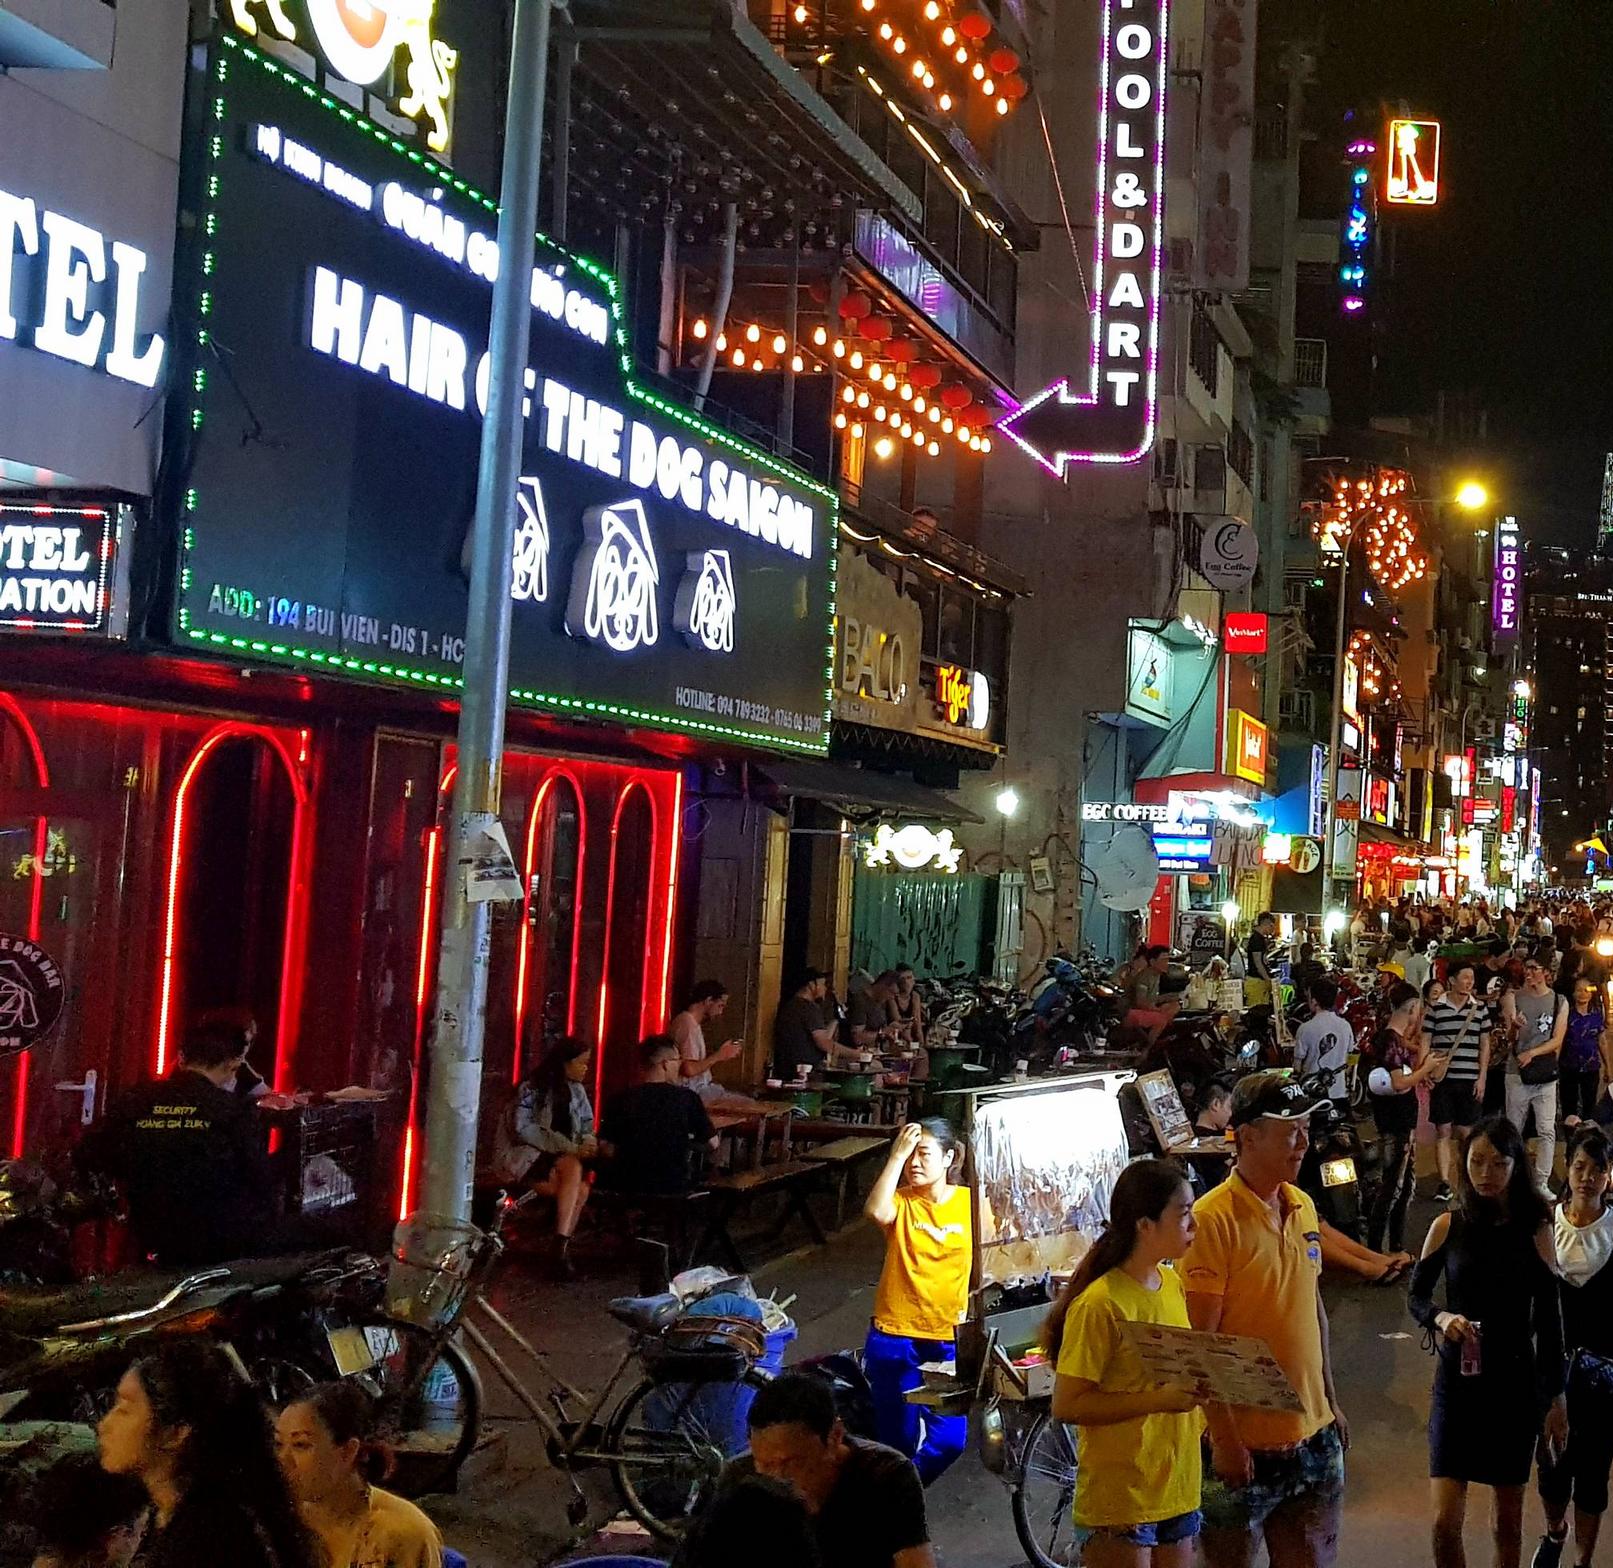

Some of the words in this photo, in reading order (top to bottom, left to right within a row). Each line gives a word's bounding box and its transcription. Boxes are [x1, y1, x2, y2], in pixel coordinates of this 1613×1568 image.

[1107, 0, 1152, 405] OOL&DART
[467, 231, 500, 282] CO
[311, 265, 467, 411] HAIR
[542, 376, 624, 480] THE
[628, 419, 703, 513] DOG
[705, 459, 814, 560] SAIGON
[0, 525, 90, 571] TEL
[0, 577, 96, 614] ATION
[1501, 551, 1517, 629] HOTEL
[207, 584, 262, 621] ADD:
[267, 596, 301, 630] 194
[304, 605, 334, 638] BUI
[340, 612, 379, 645] VIEN
[390, 623, 415, 652] DIS
[418, 630, 428, 656] 1
[441, 633, 466, 662] HC
[676, 686, 715, 712] HOTLINE:
[939, 665, 971, 724] Tiger
